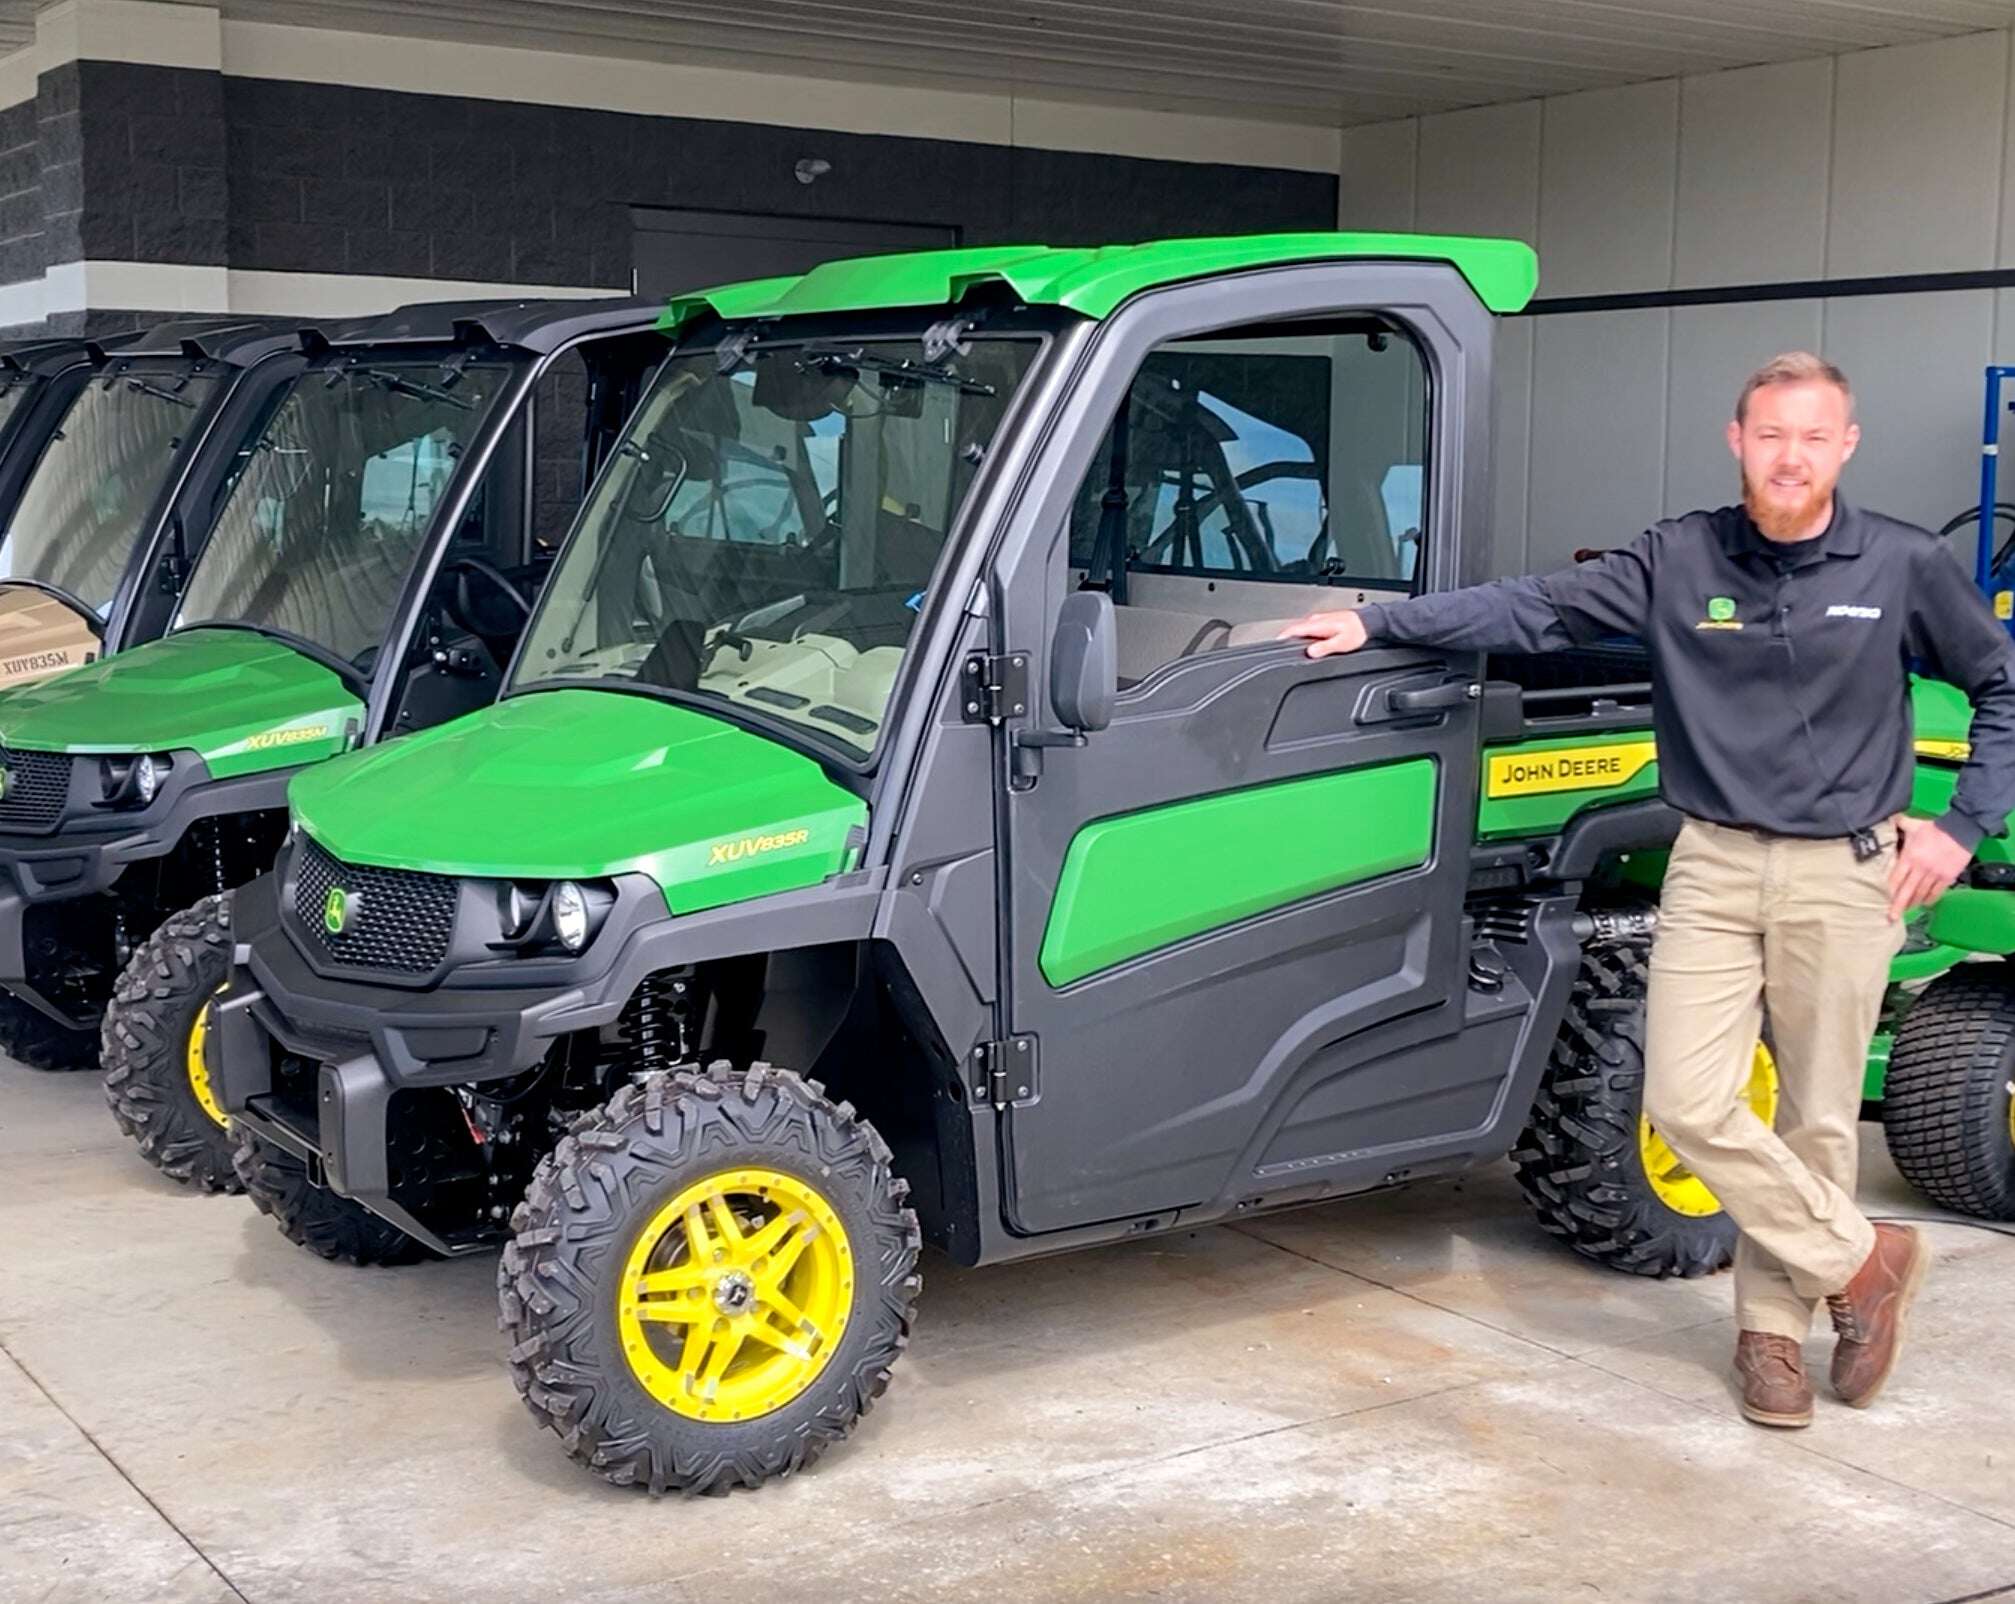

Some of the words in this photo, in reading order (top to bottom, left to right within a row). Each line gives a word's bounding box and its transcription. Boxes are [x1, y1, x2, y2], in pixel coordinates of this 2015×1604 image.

[1501, 764, 1554, 784] JOHN
[1558, 757, 1621, 778] DEERE
[707, 828, 809, 866] XUV835R
